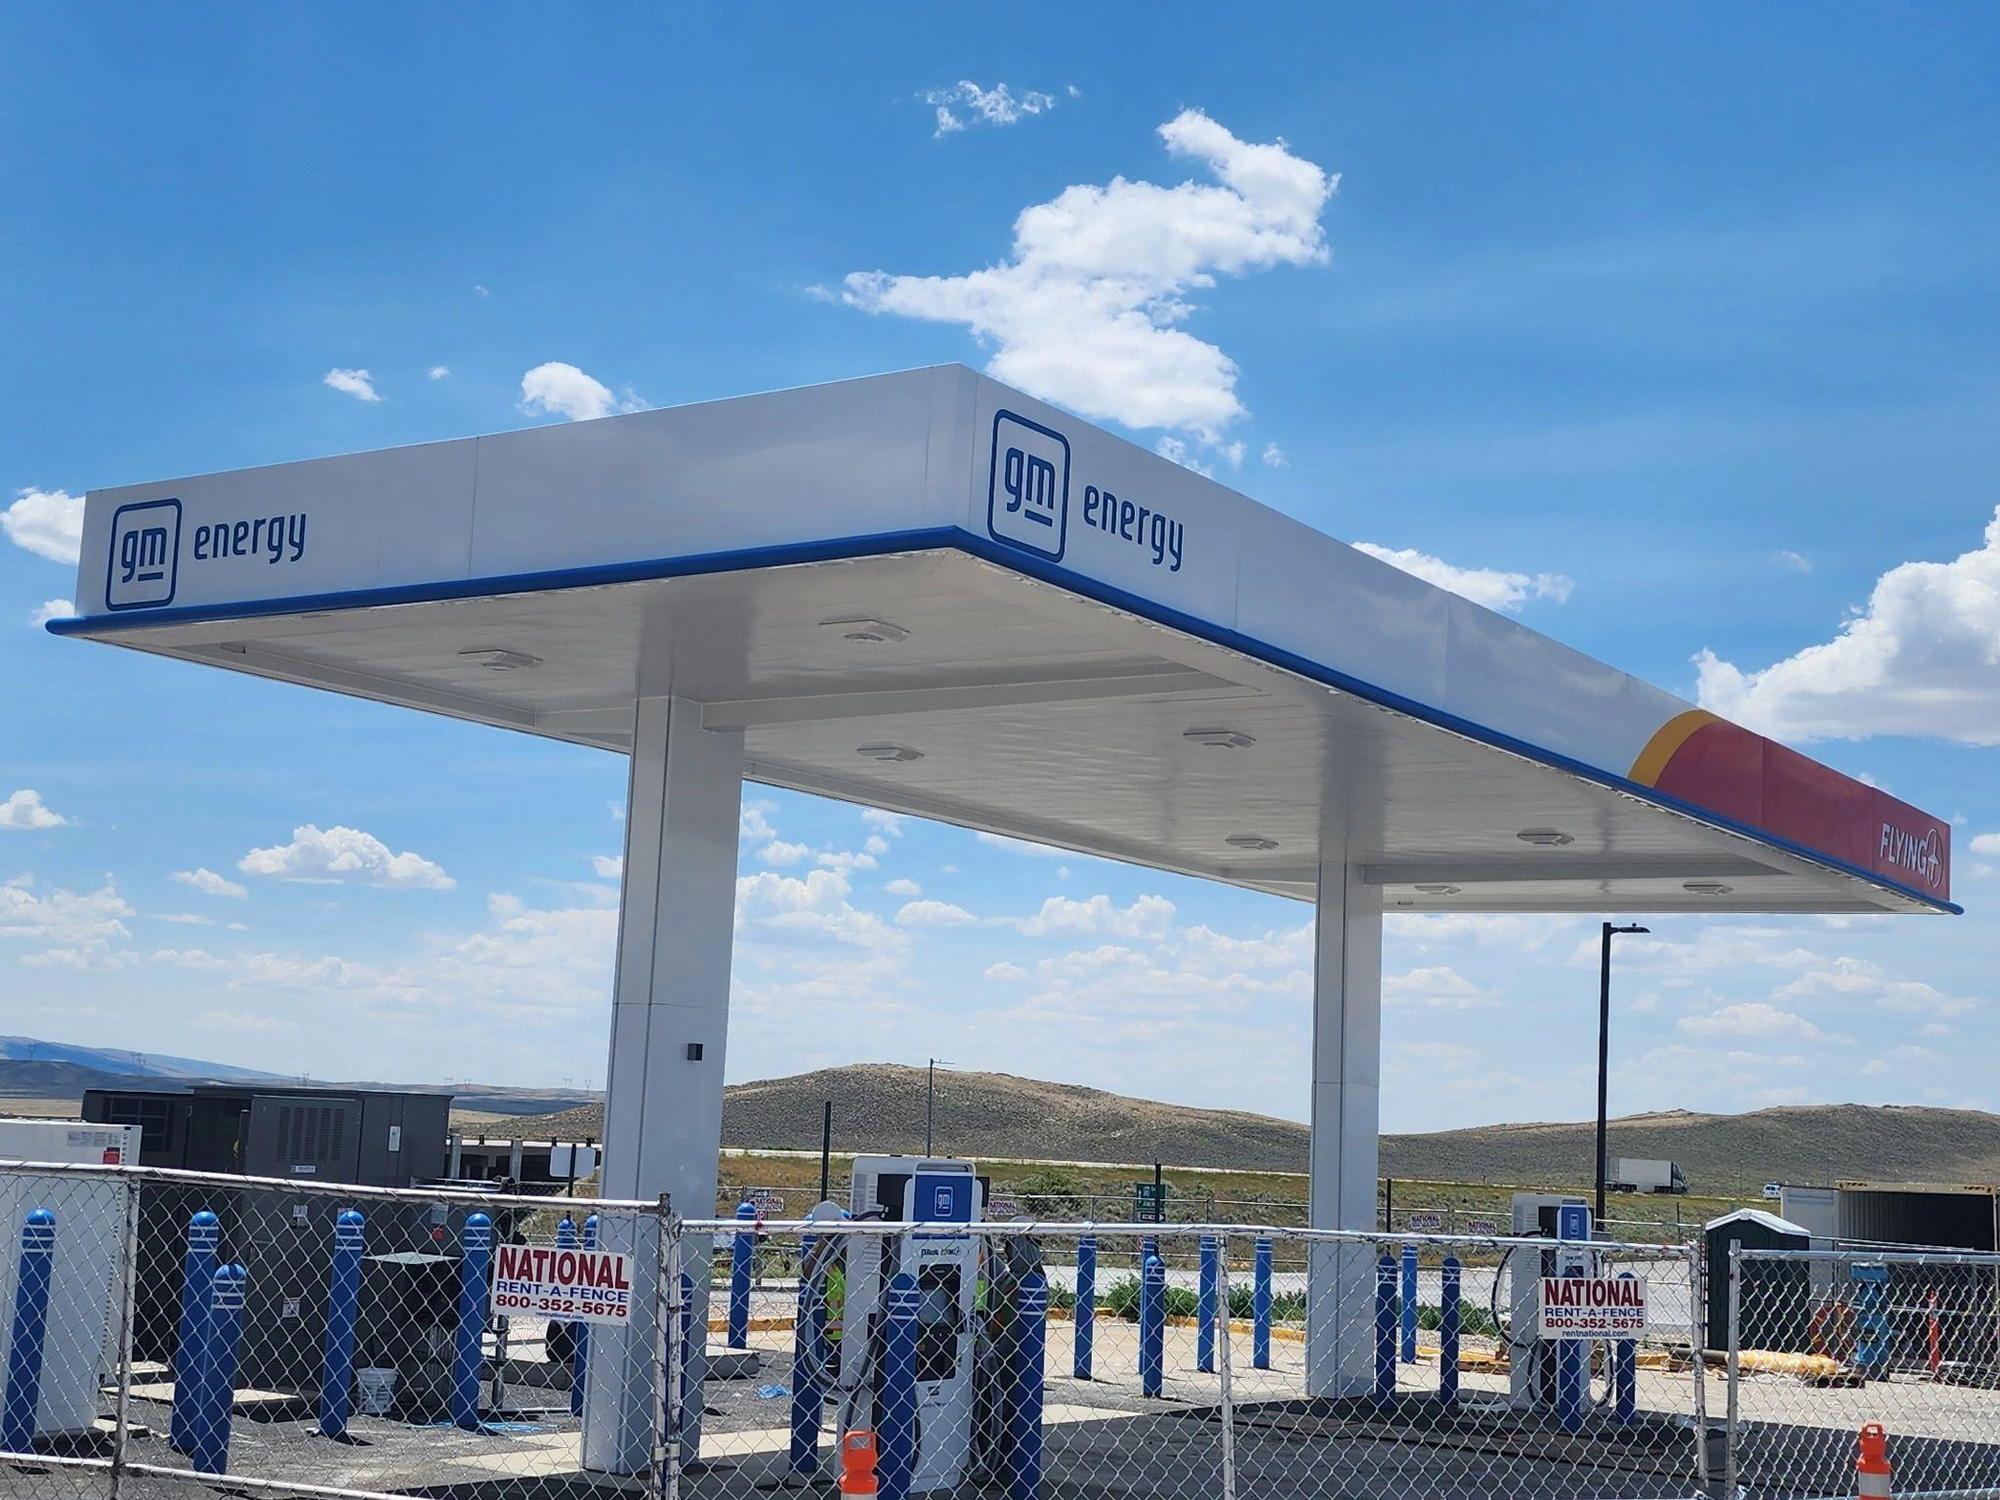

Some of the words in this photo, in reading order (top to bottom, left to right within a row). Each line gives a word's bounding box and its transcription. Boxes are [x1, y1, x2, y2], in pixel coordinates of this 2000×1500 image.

[1004, 447, 1056, 514] gm
[1083, 485, 1184, 572] energy
[121, 527, 168, 583] gm
[193, 513, 307, 564] energy
[1880, 823, 1927, 876] FLYING
[498, 1247, 630, 1290] NATIONAL
[496, 1280, 630, 1303] RENT-A-FENCE
[1544, 1278, 1644, 1307] NATIONAL
[495, 1294, 628, 1318] 800-352-5675
[1544, 1307, 1645, 1318] RENT-A-FENCE
[1545, 1317, 1645, 1329] 800-352-5675
[1561, 1329, 1630, 1338] rentnational.com
